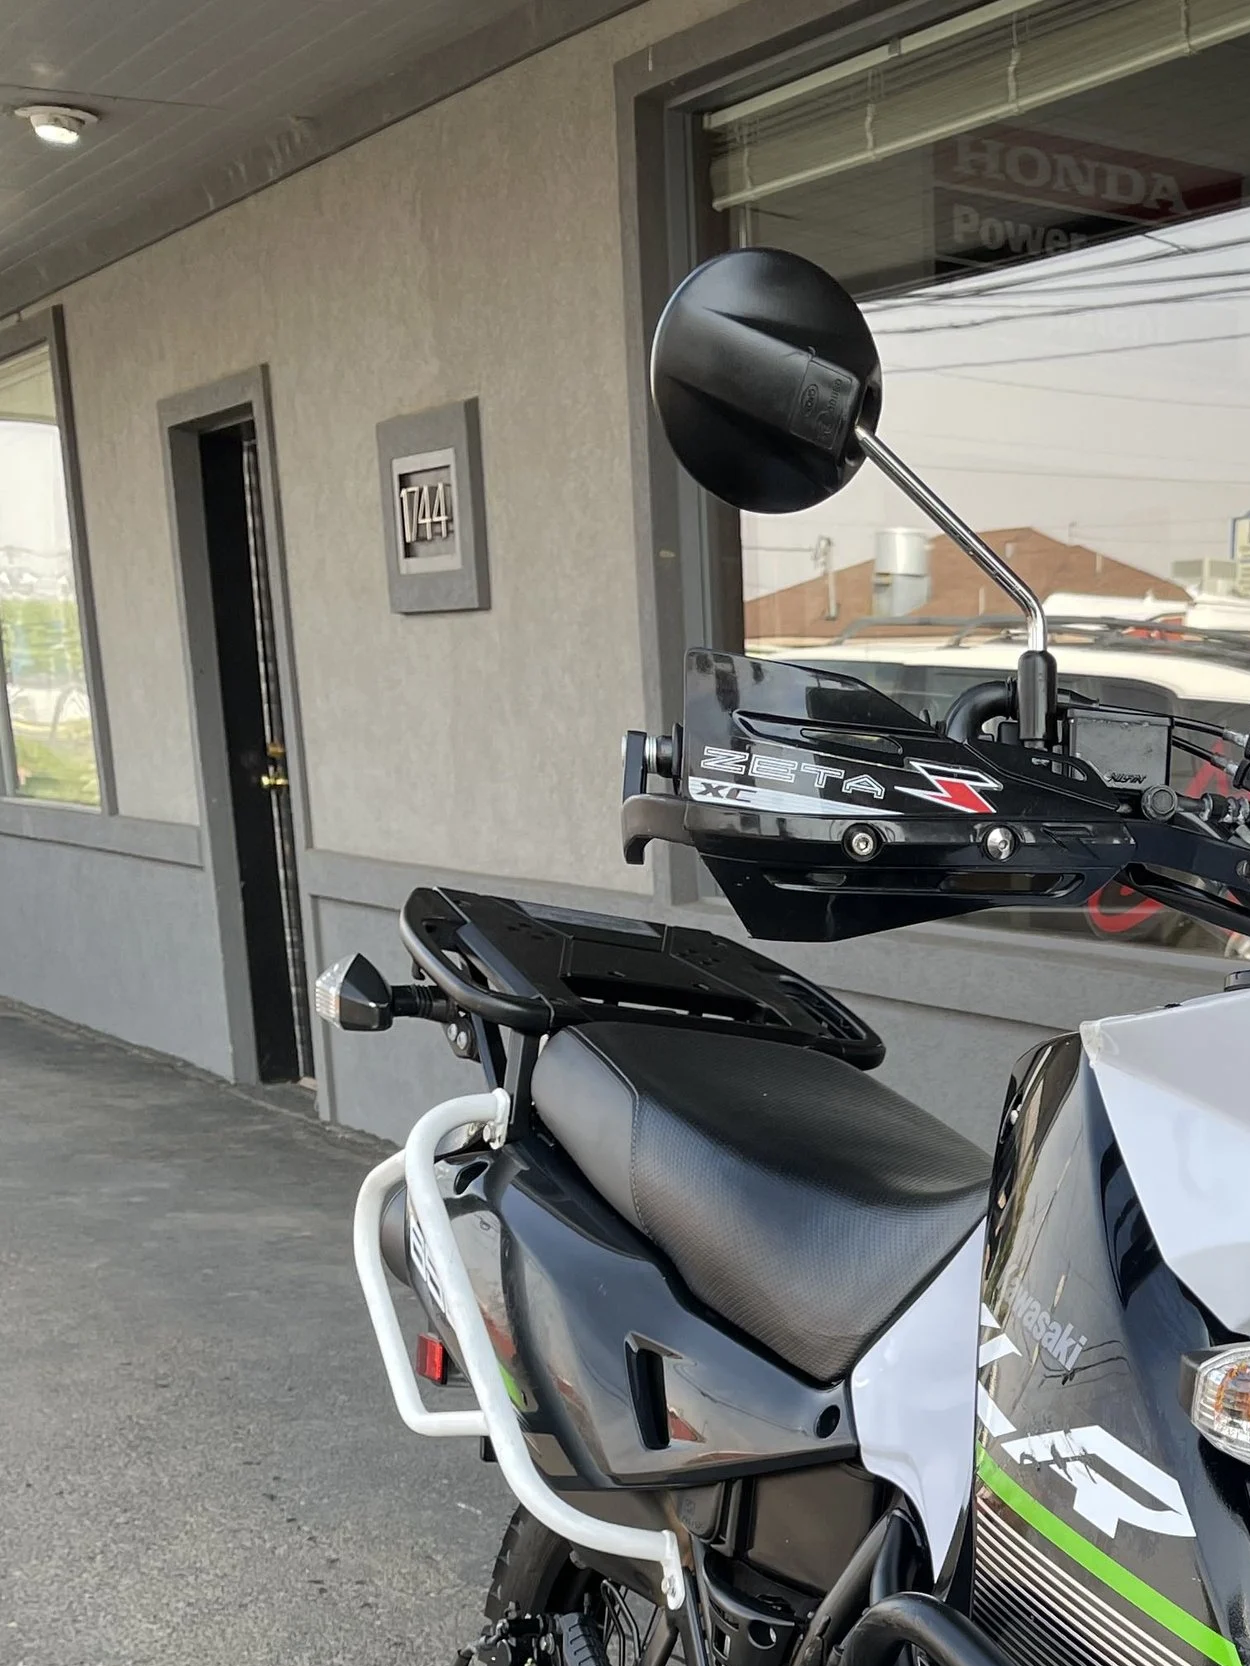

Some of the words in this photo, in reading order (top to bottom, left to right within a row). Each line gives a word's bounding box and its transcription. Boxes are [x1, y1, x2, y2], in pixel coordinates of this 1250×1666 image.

[955, 136, 1188, 214] HONDA
[400, 482, 449, 543] 1744
[695, 780, 757, 802] XC
[700, 745, 886, 801] ZETA
